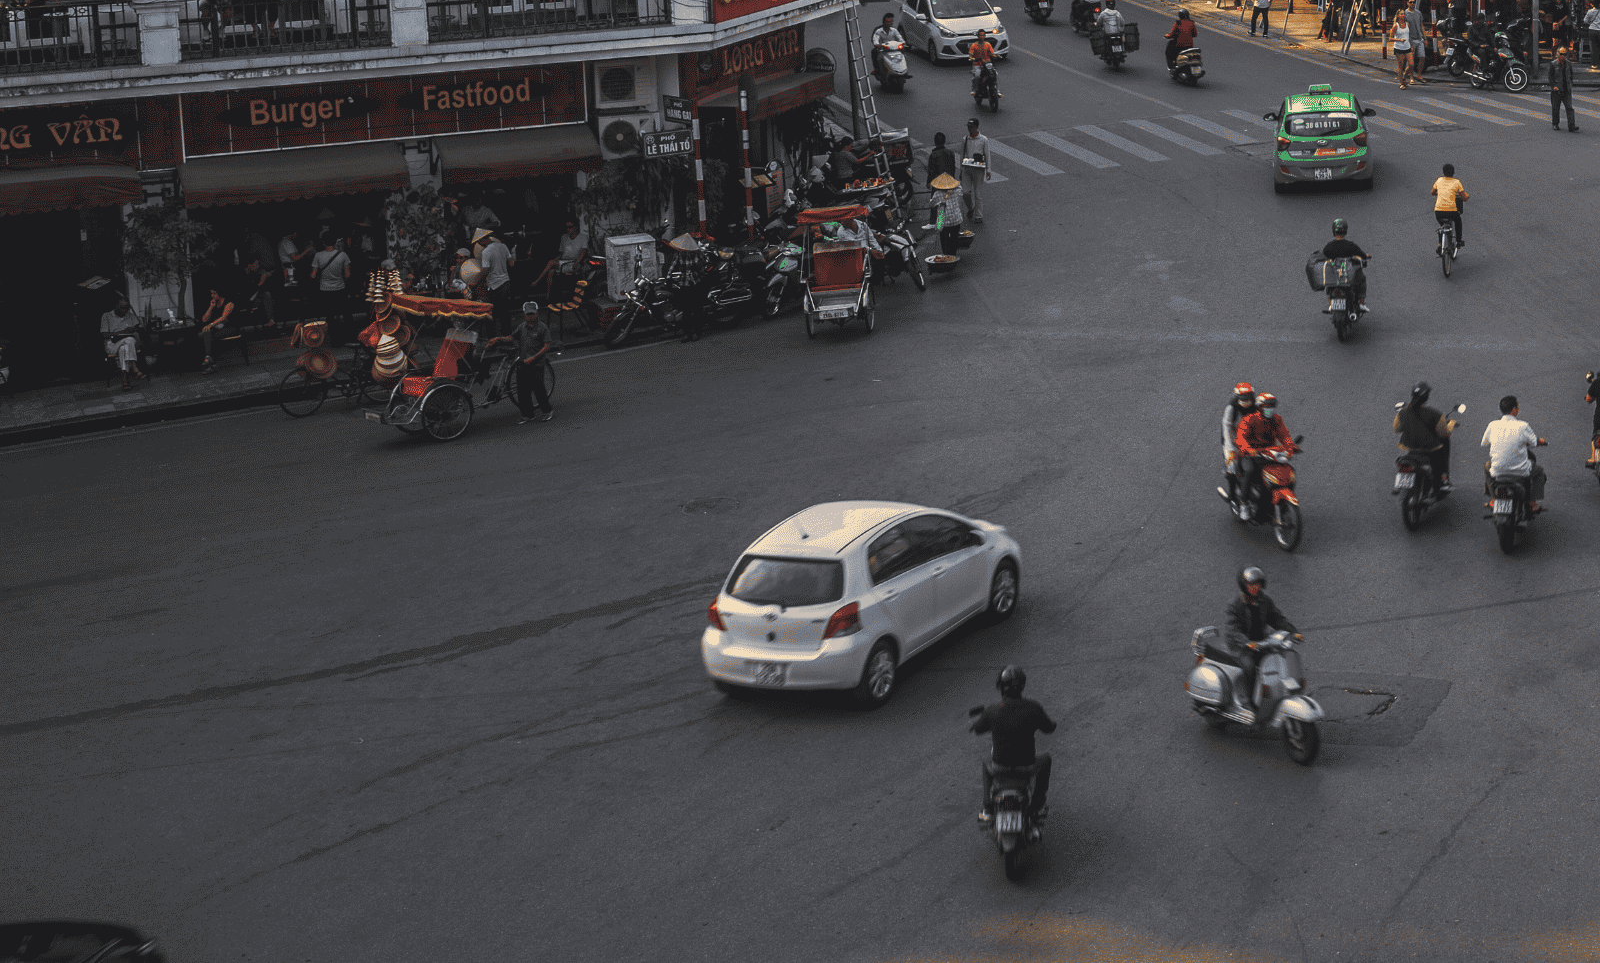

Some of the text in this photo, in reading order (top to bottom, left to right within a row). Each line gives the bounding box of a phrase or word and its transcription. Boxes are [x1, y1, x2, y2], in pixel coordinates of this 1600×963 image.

[722, 40, 764, 76] LONG
[422, 78, 531, 113] Fastfood
[46, 113, 123, 147] VÂN
[249, 98, 344, 129] Burger
[647, 143, 657, 155] LÊ
[659, 140, 678, 154] THÁI
